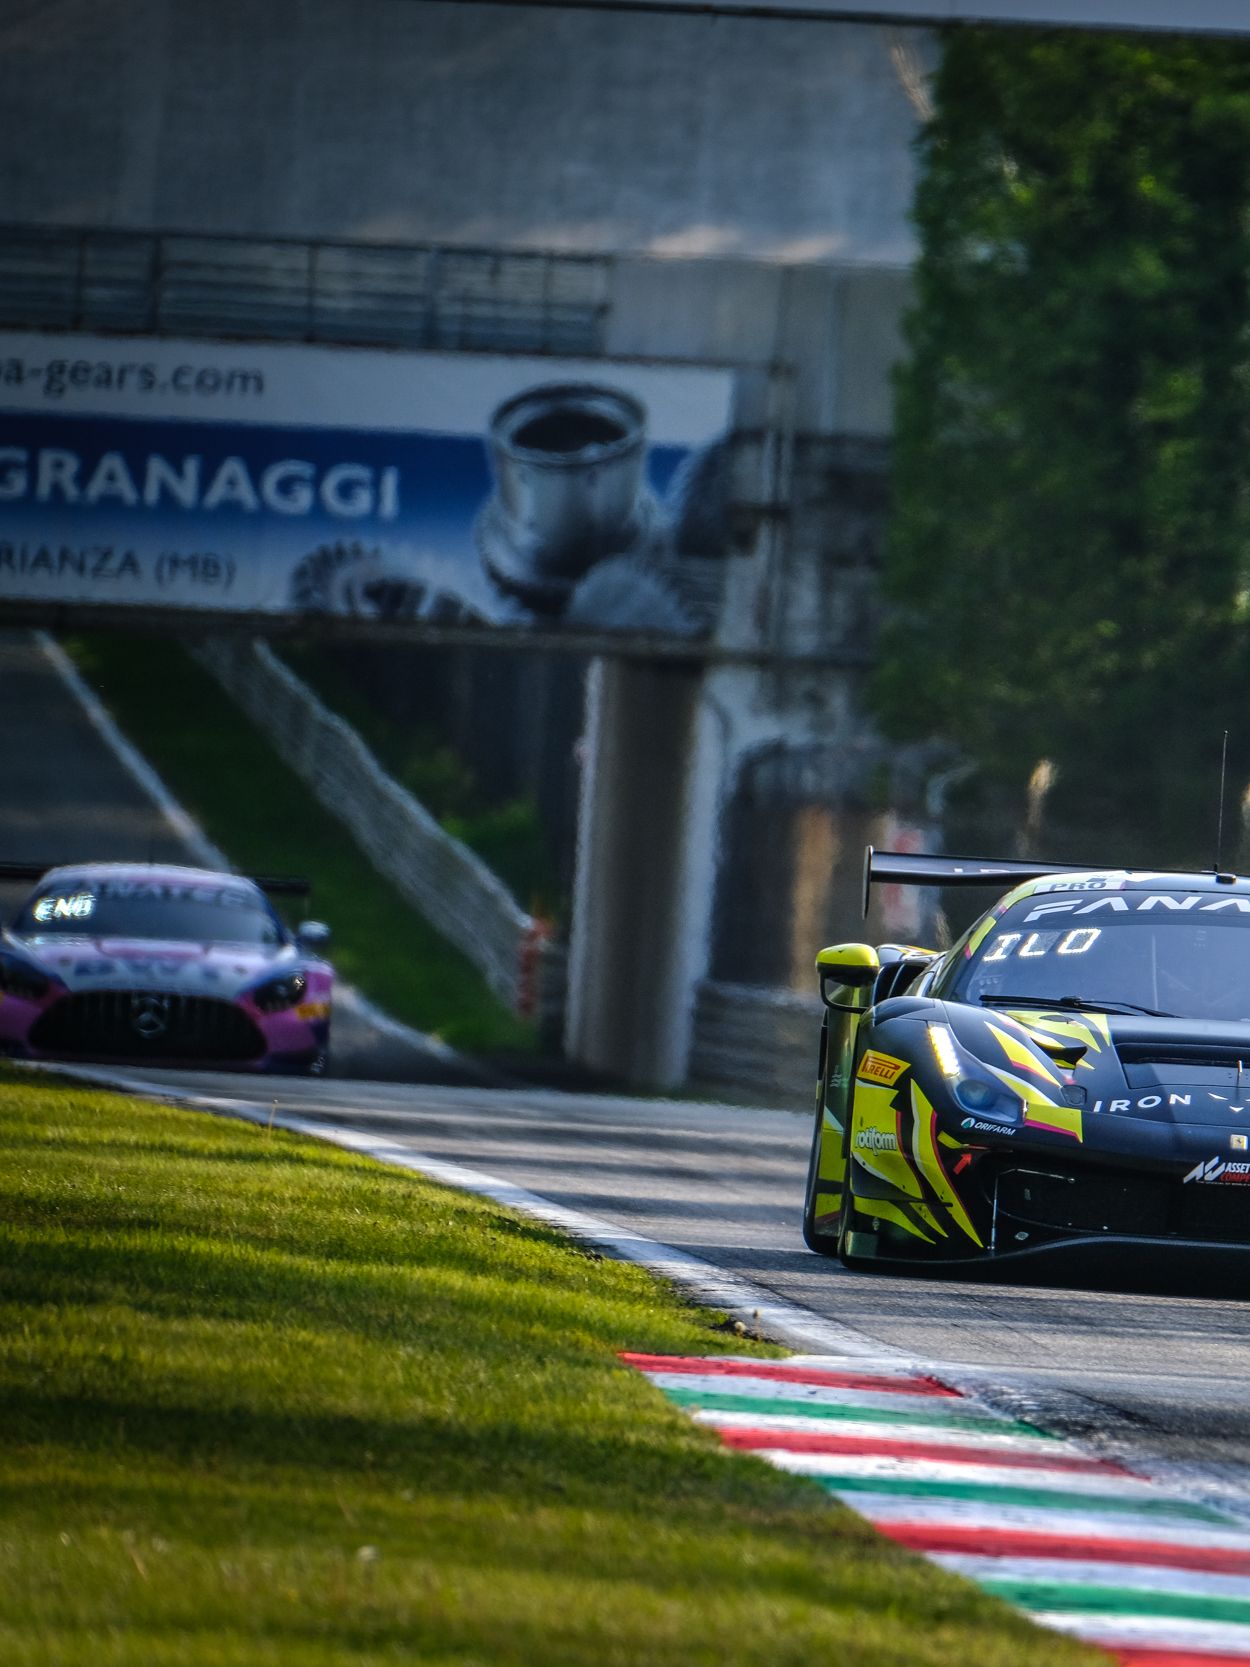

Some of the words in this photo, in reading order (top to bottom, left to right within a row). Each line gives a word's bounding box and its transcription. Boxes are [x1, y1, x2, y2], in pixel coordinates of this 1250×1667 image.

[0, 357, 265, 398] a-gears.com
[155, 551, 237, 588] (MB)
[1049, 881, 1107, 892] PRO
[862, 1055, 902, 1080] PIRELLI
[1093, 1093, 1192, 1113] IRON
[974, 1121, 1016, 1137] ORIFARM
